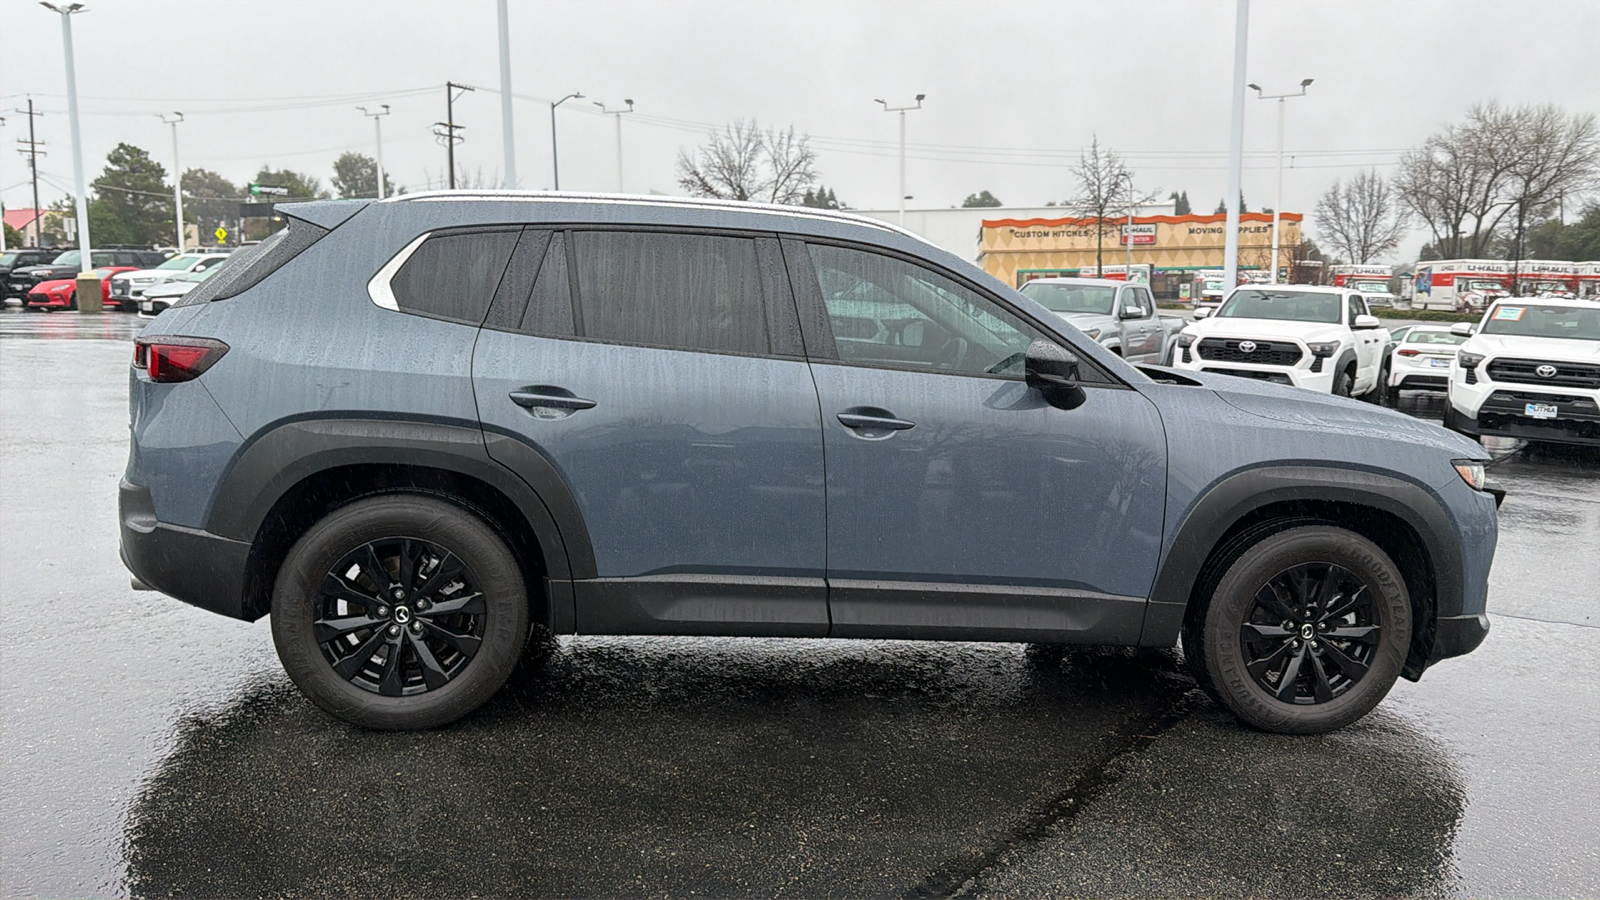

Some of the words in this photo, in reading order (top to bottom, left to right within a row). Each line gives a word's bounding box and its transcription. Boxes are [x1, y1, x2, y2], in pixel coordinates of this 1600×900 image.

[1014, 230, 1050, 238] CUSTOM
[1052, 230, 1089, 238] HITCHES
[1188, 227, 1223, 235] MOVING
[1238, 226, 1268, 234] PPLIES
[1467, 264, 1505, 272] U-HAUL
